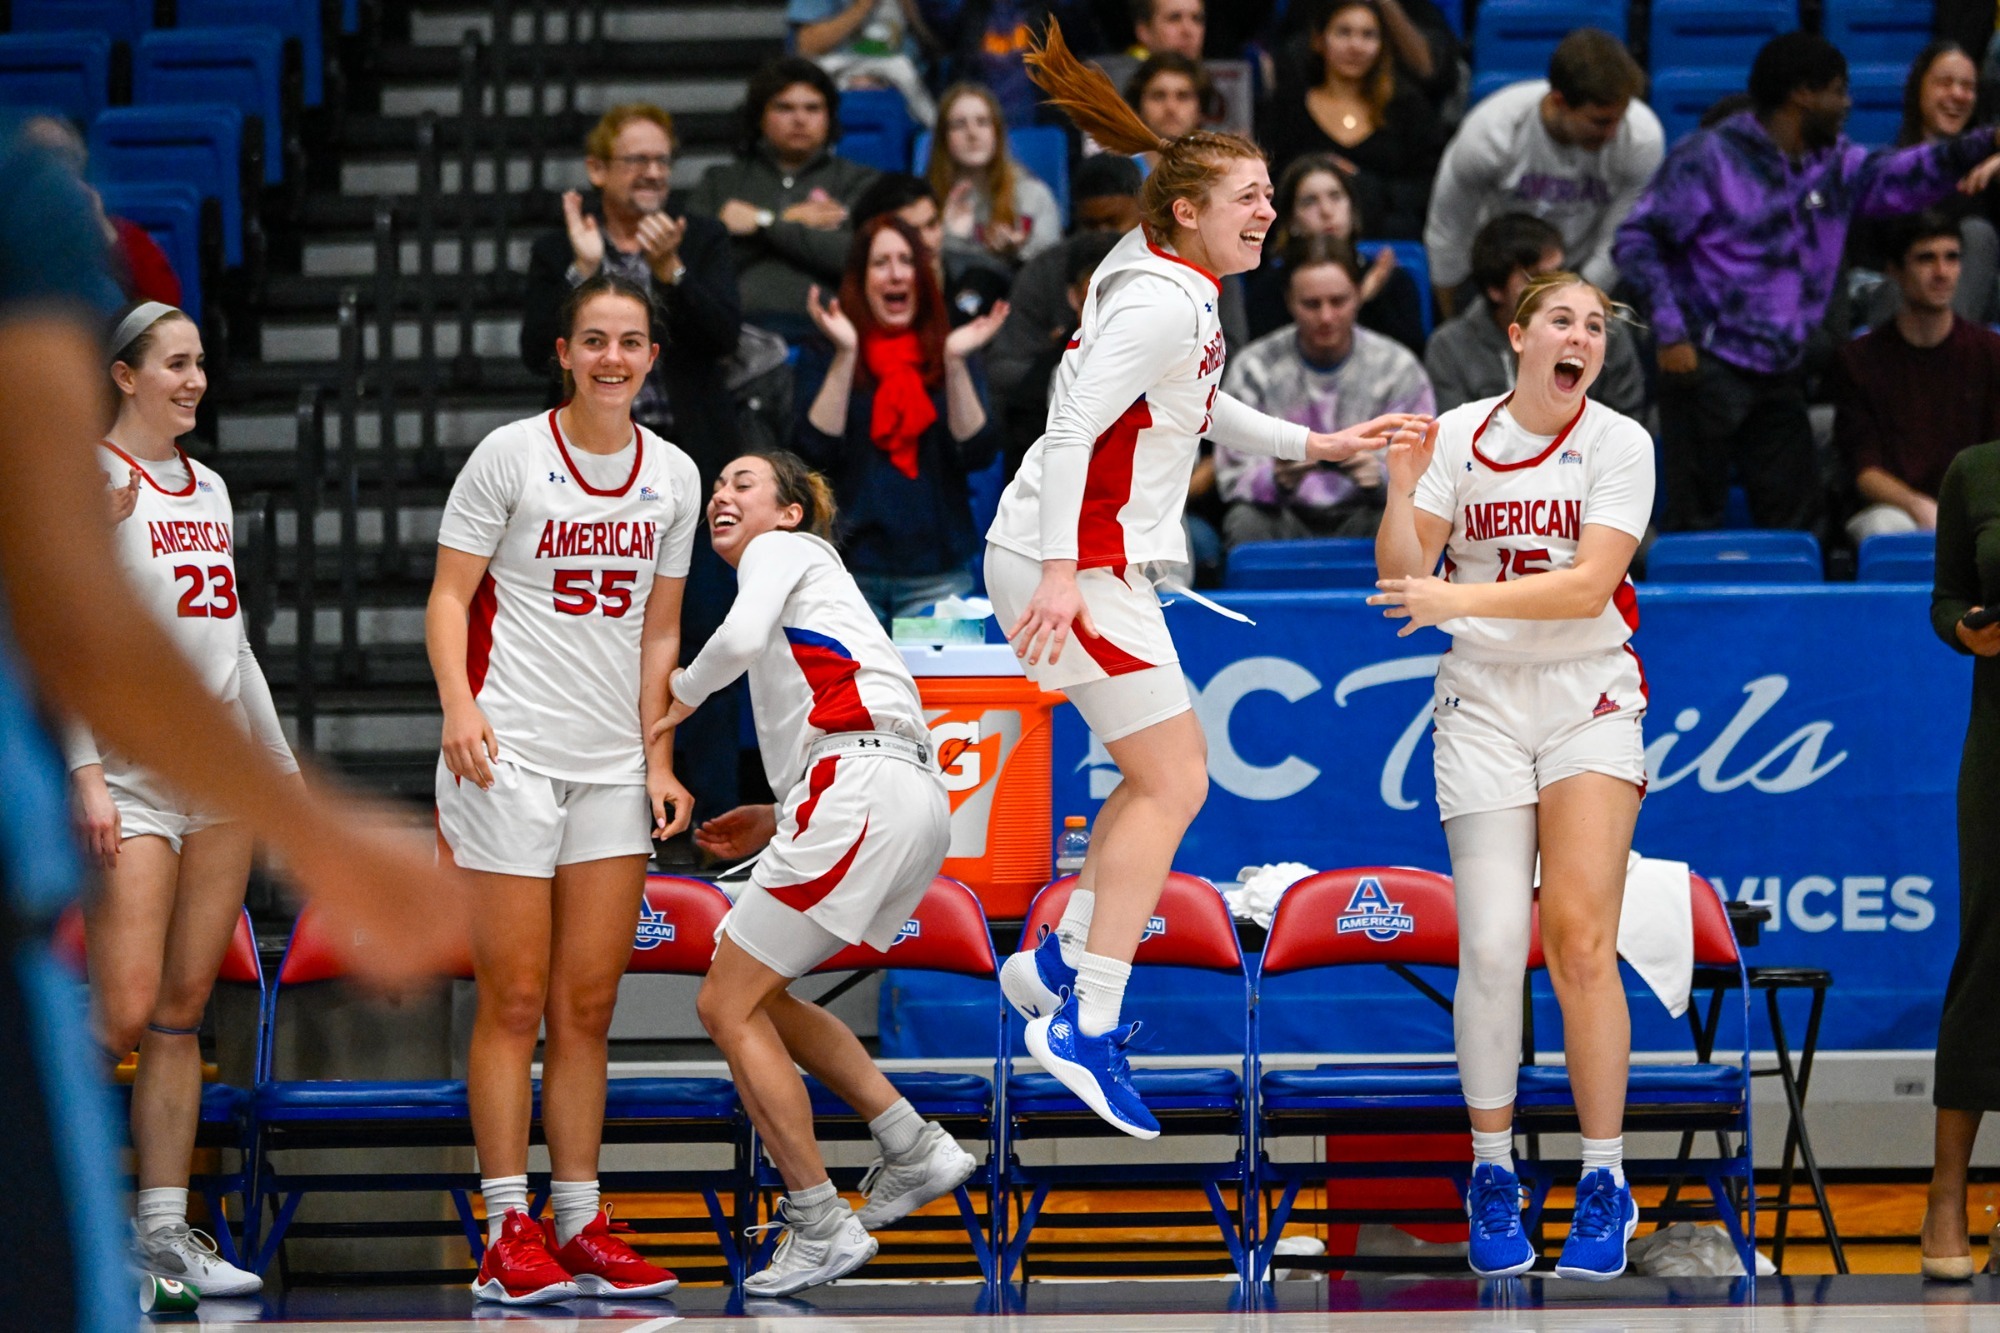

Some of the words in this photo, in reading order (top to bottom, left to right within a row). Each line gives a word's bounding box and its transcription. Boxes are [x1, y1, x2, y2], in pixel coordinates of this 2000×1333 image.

[535, 518, 657, 561] AMERICAN
[1465, 499, 1582, 542] AMERICAN
[173, 564, 238, 620] 23
[552, 568, 638, 619] 55
[1334, 653, 1848, 811] Tils
[928, 720, 981, 792] G
[636, 925, 672, 937] RICAN
[1341, 916, 1410, 930] AMERICAN
